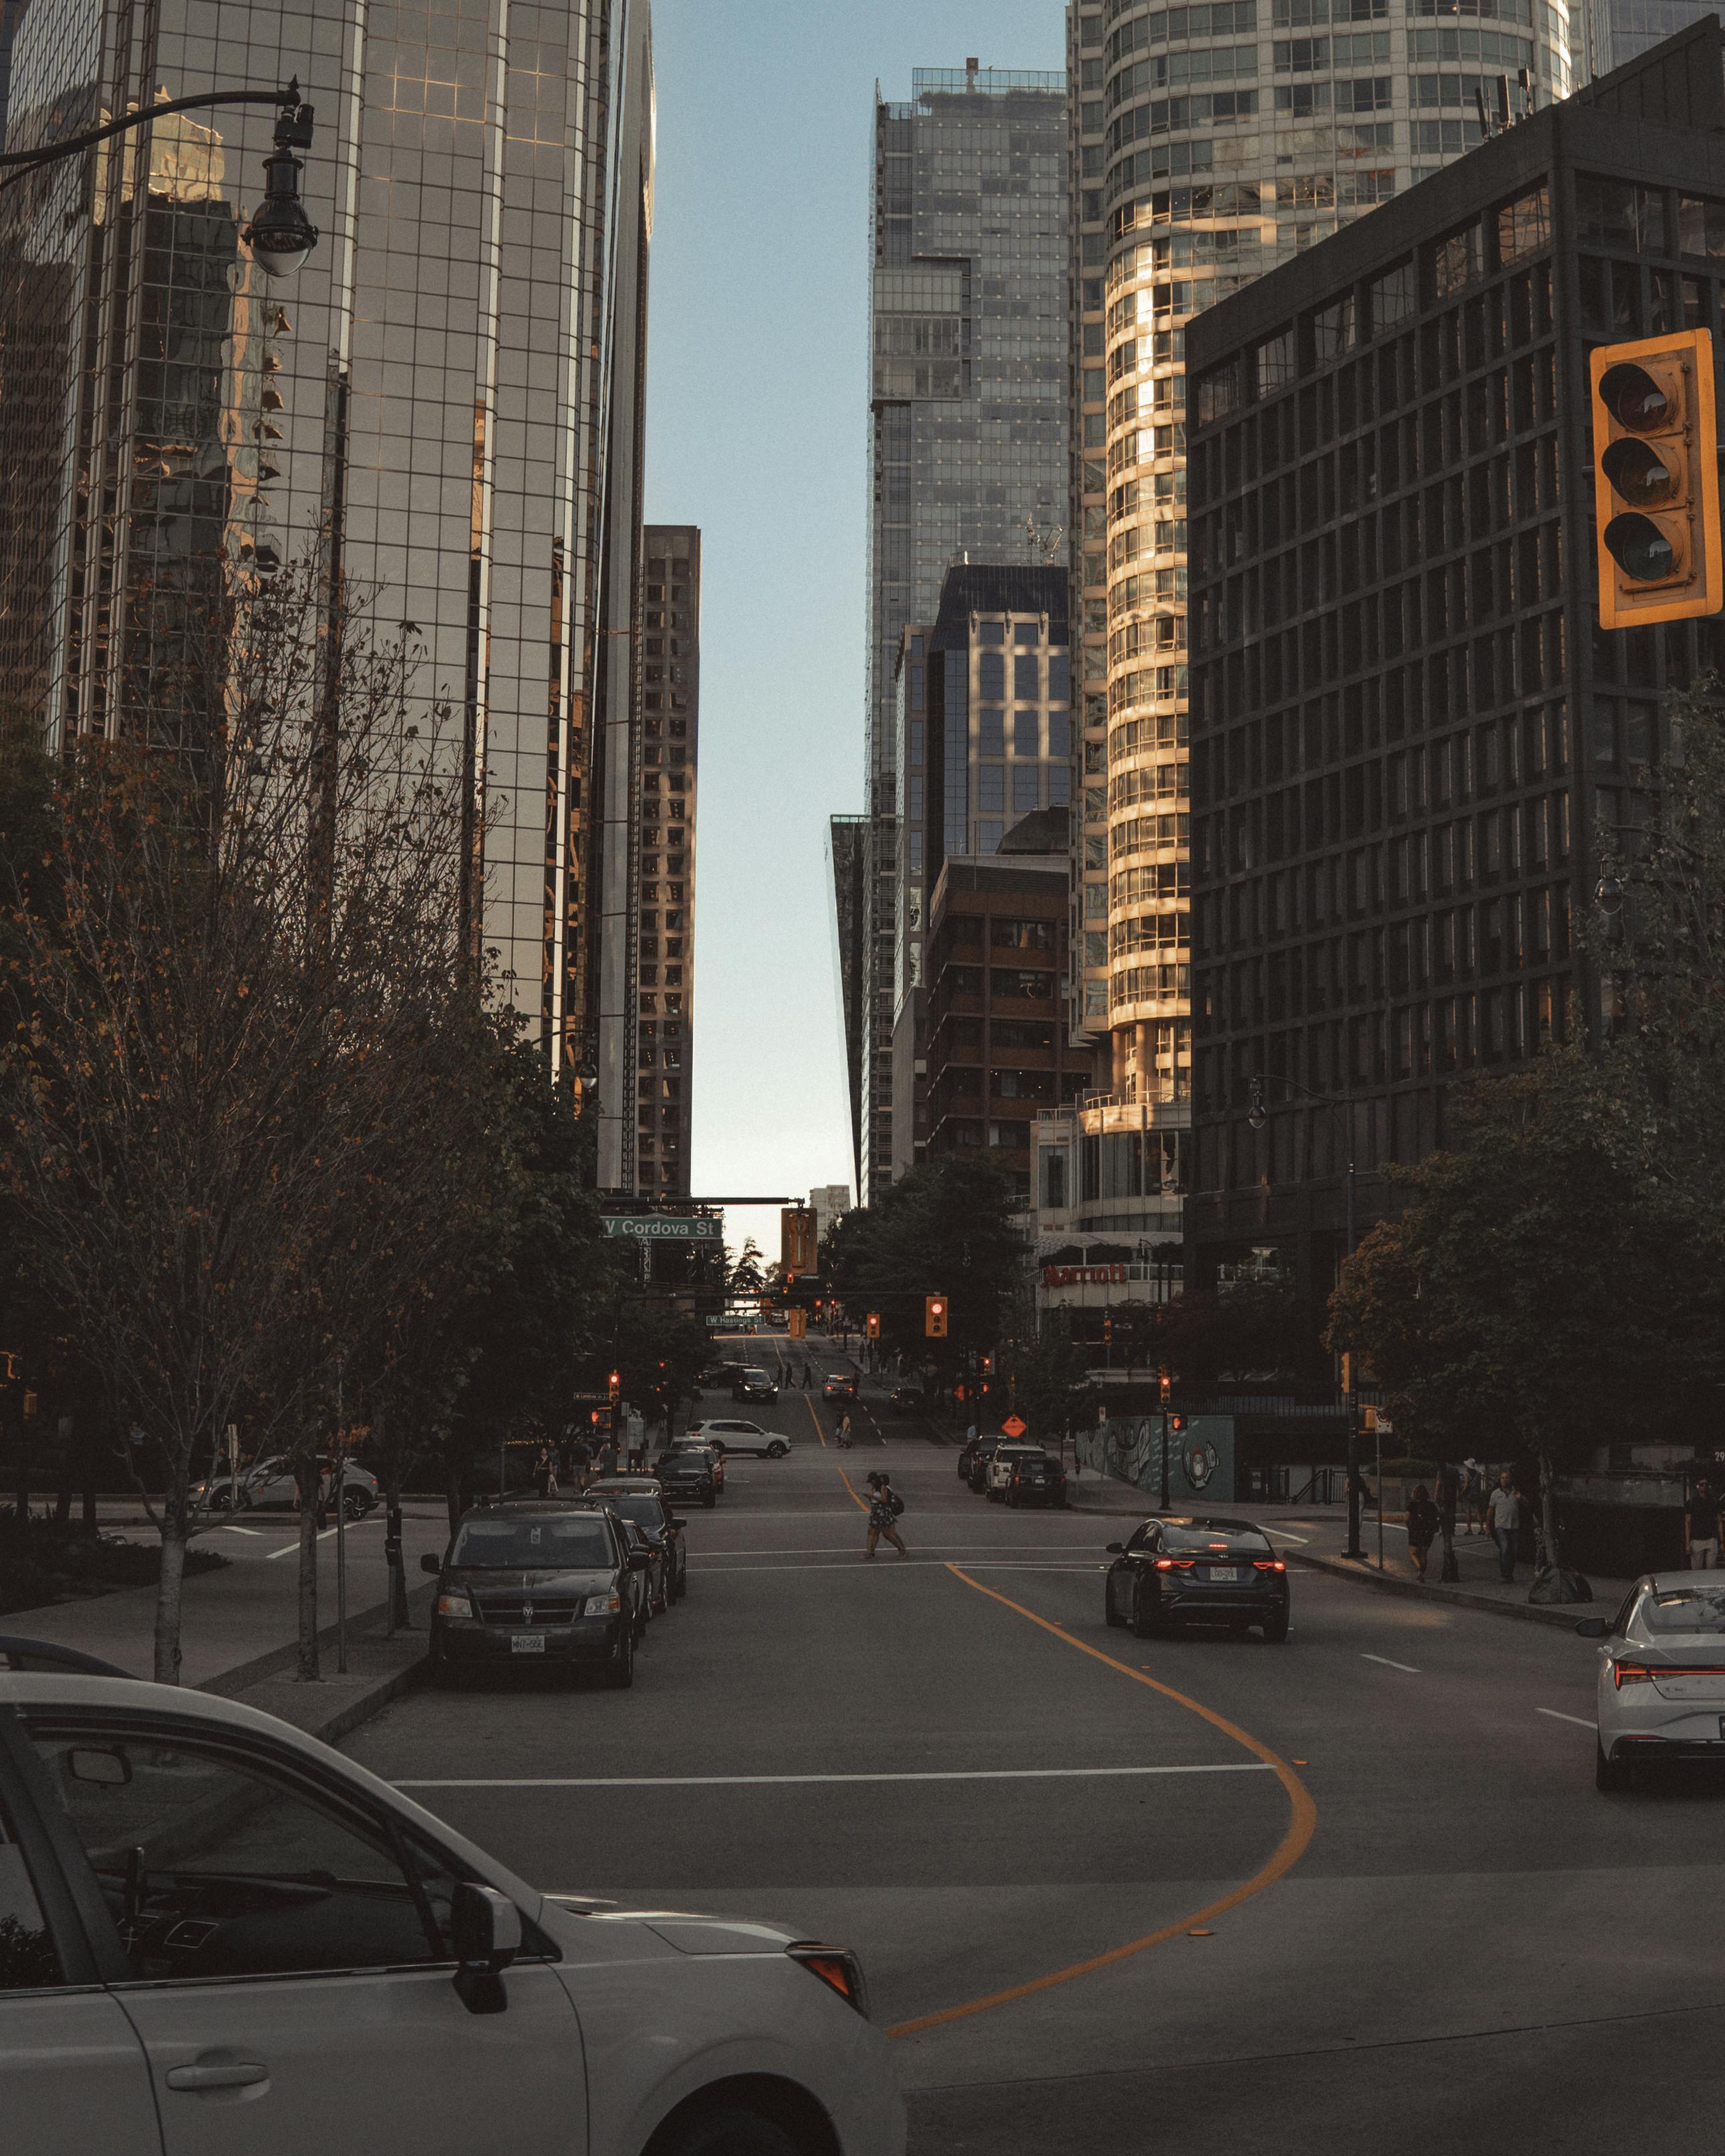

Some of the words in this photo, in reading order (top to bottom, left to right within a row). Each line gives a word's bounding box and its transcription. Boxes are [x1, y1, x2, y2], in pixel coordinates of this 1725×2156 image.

[621, 1220, 689, 1235] Cordova
[696, 1221, 714, 1235] St
[1040, 1262, 1125, 1289] Marriott
[720, 1316, 752, 1324] Hastings
